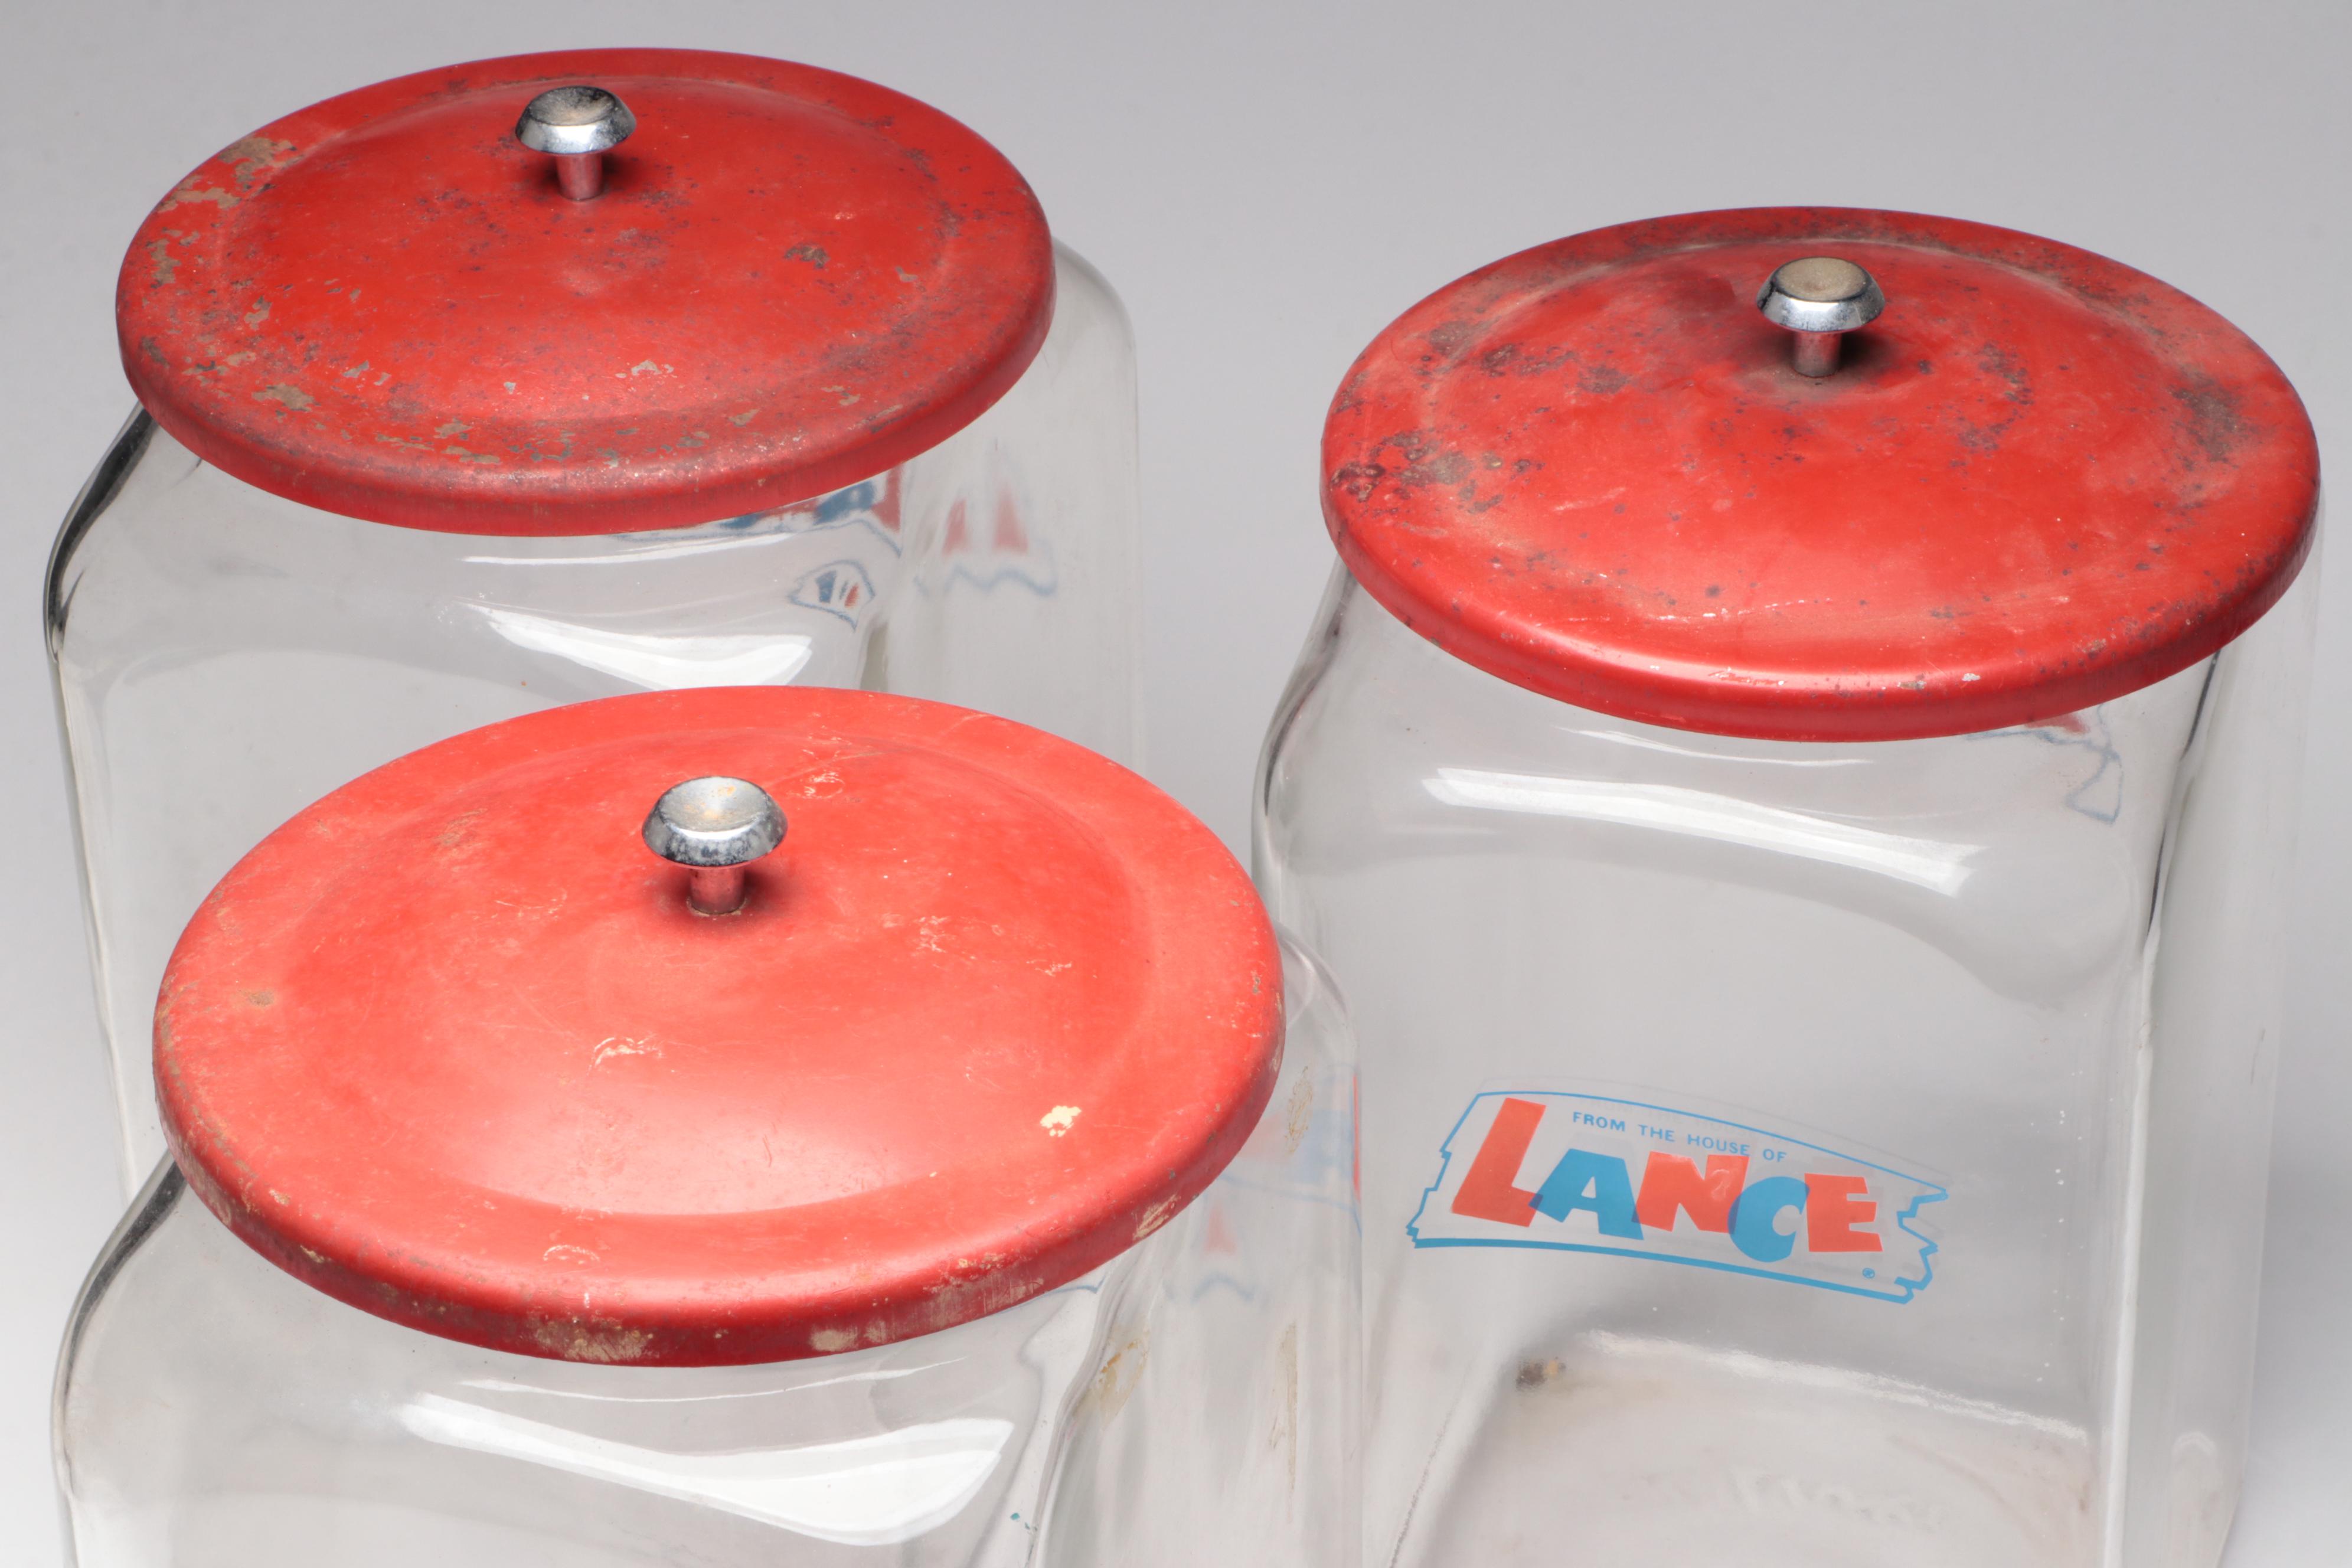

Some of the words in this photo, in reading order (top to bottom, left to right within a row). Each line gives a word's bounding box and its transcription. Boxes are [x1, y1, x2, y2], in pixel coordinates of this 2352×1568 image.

[1450, 1097, 1883, 1263] LANCE
[1573, 1111, 1626, 1132] FROM
[1638, 1124, 1675, 1142] THE
[1687, 1133, 1750, 1157] HOUSE
[1763, 1148, 1788, 1162] OF
